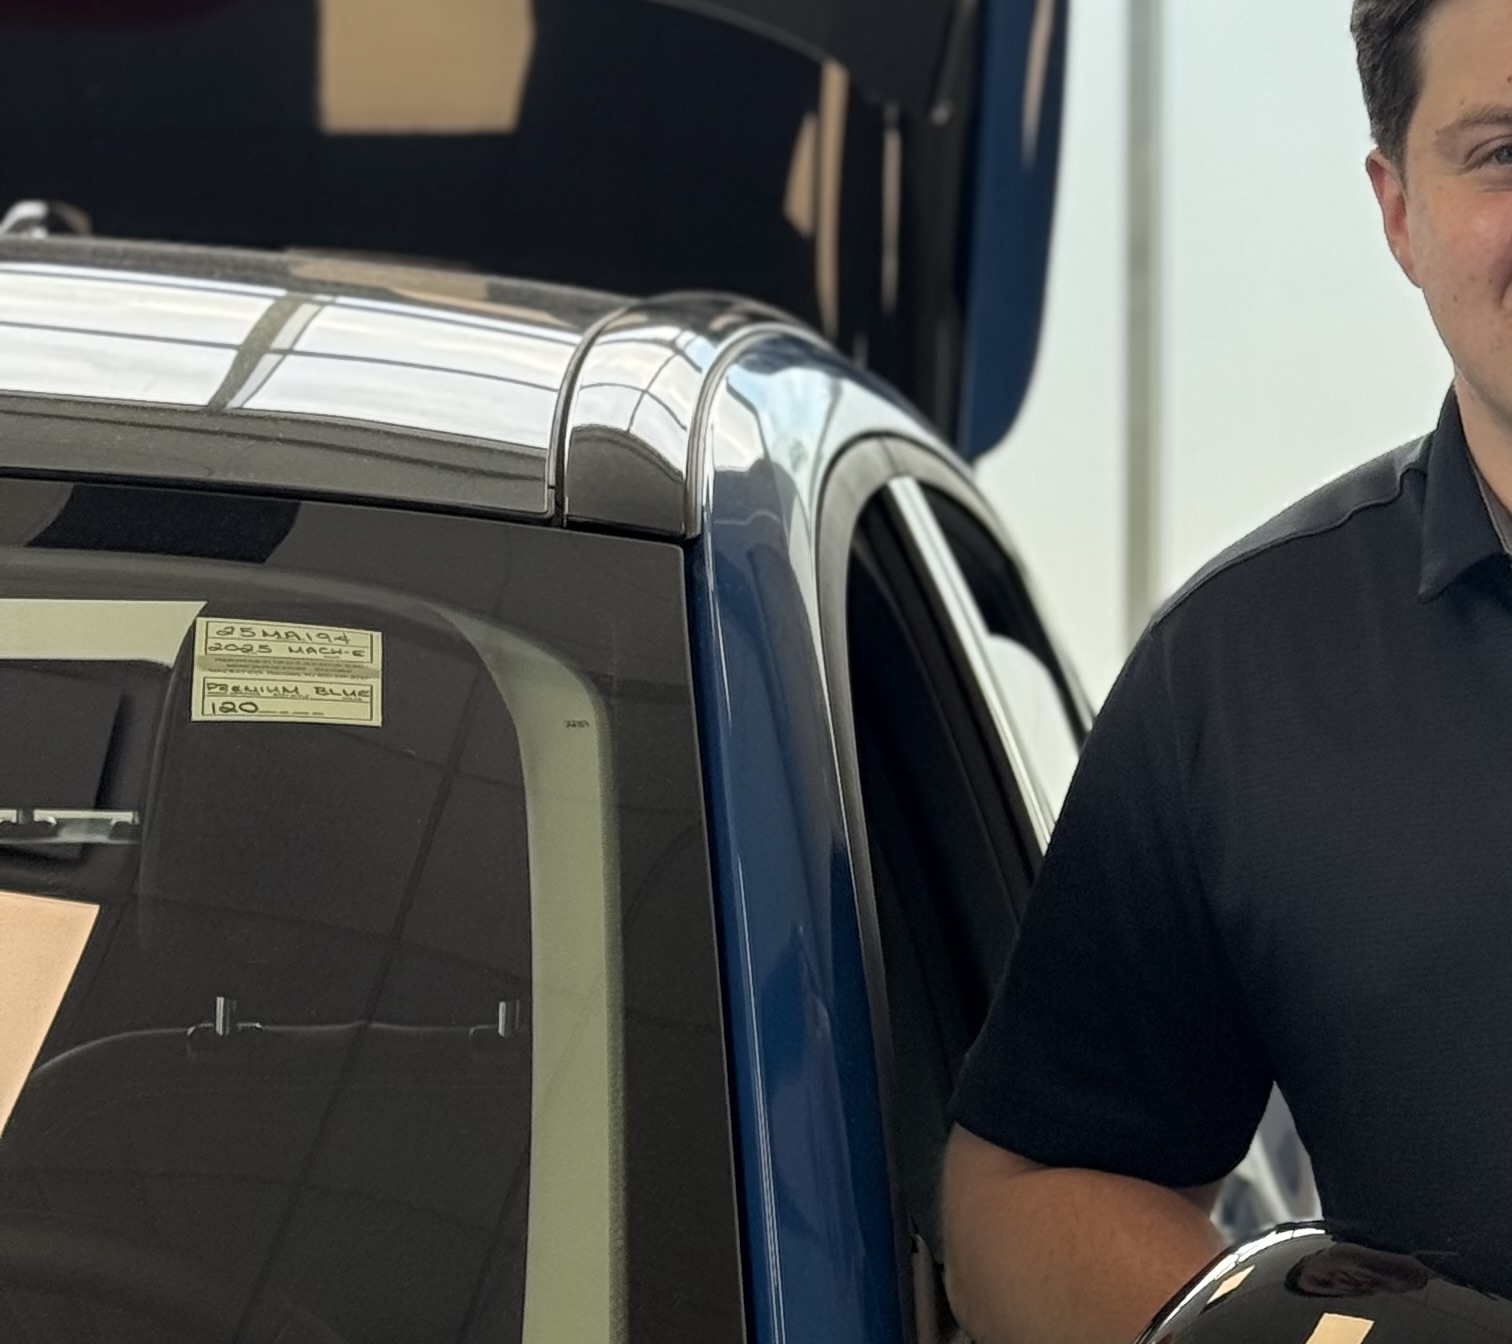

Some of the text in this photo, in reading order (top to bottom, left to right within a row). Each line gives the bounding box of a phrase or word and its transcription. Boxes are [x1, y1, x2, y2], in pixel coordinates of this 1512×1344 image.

[216, 626, 350, 644] 25MA194
[207, 642, 366, 657] 2025 MACH-E
[206, 682, 371, 697] PREMIUM BLUE
[211, 702, 259, 716] 120
